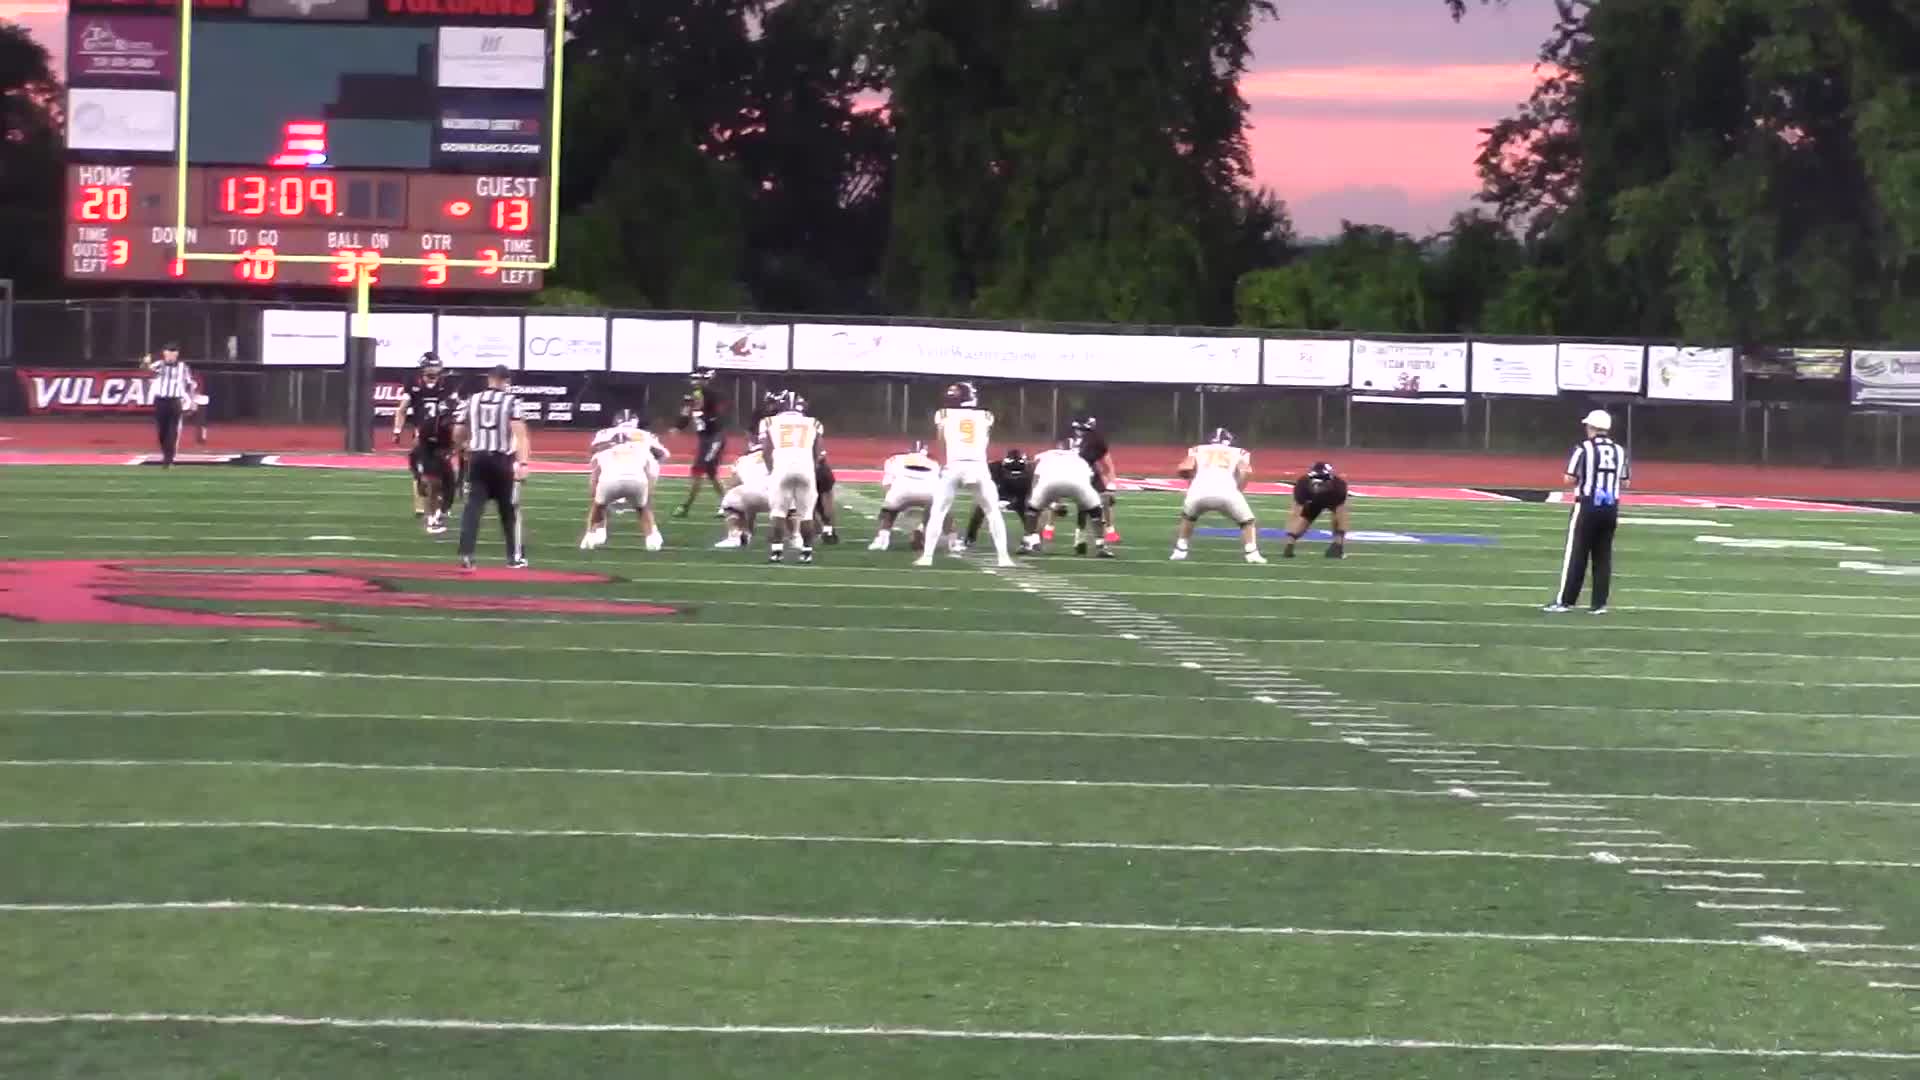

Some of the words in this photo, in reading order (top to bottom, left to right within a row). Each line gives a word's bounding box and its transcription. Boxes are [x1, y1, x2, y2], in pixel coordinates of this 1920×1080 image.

[79, 166, 133, 186] HOME
[476, 178, 539, 197] GUEST
[80, 187, 129, 220] 20
[493, 199, 529, 232] 13
[78, 228, 108, 241] TIME
[228, 229, 248, 245] TO
[257, 230, 279, 246] GO
[328, 232, 363, 248] BALL
[371, 233, 389, 249] ON
[503, 239, 533, 253] TIME
[72, 243, 108, 257] OUTS
[109, 239, 129, 265] 3
[74, 259, 108, 273] LEFT
[423, 252, 447, 285] 3
[478, 249, 499, 275] 3
[501, 271, 535, 284] LEFT
[32, 377, 158, 408] VULCA
[779, 423, 809, 449] 27
[959, 418, 976, 444] 9
[1599, 444, 1615, 470] R
